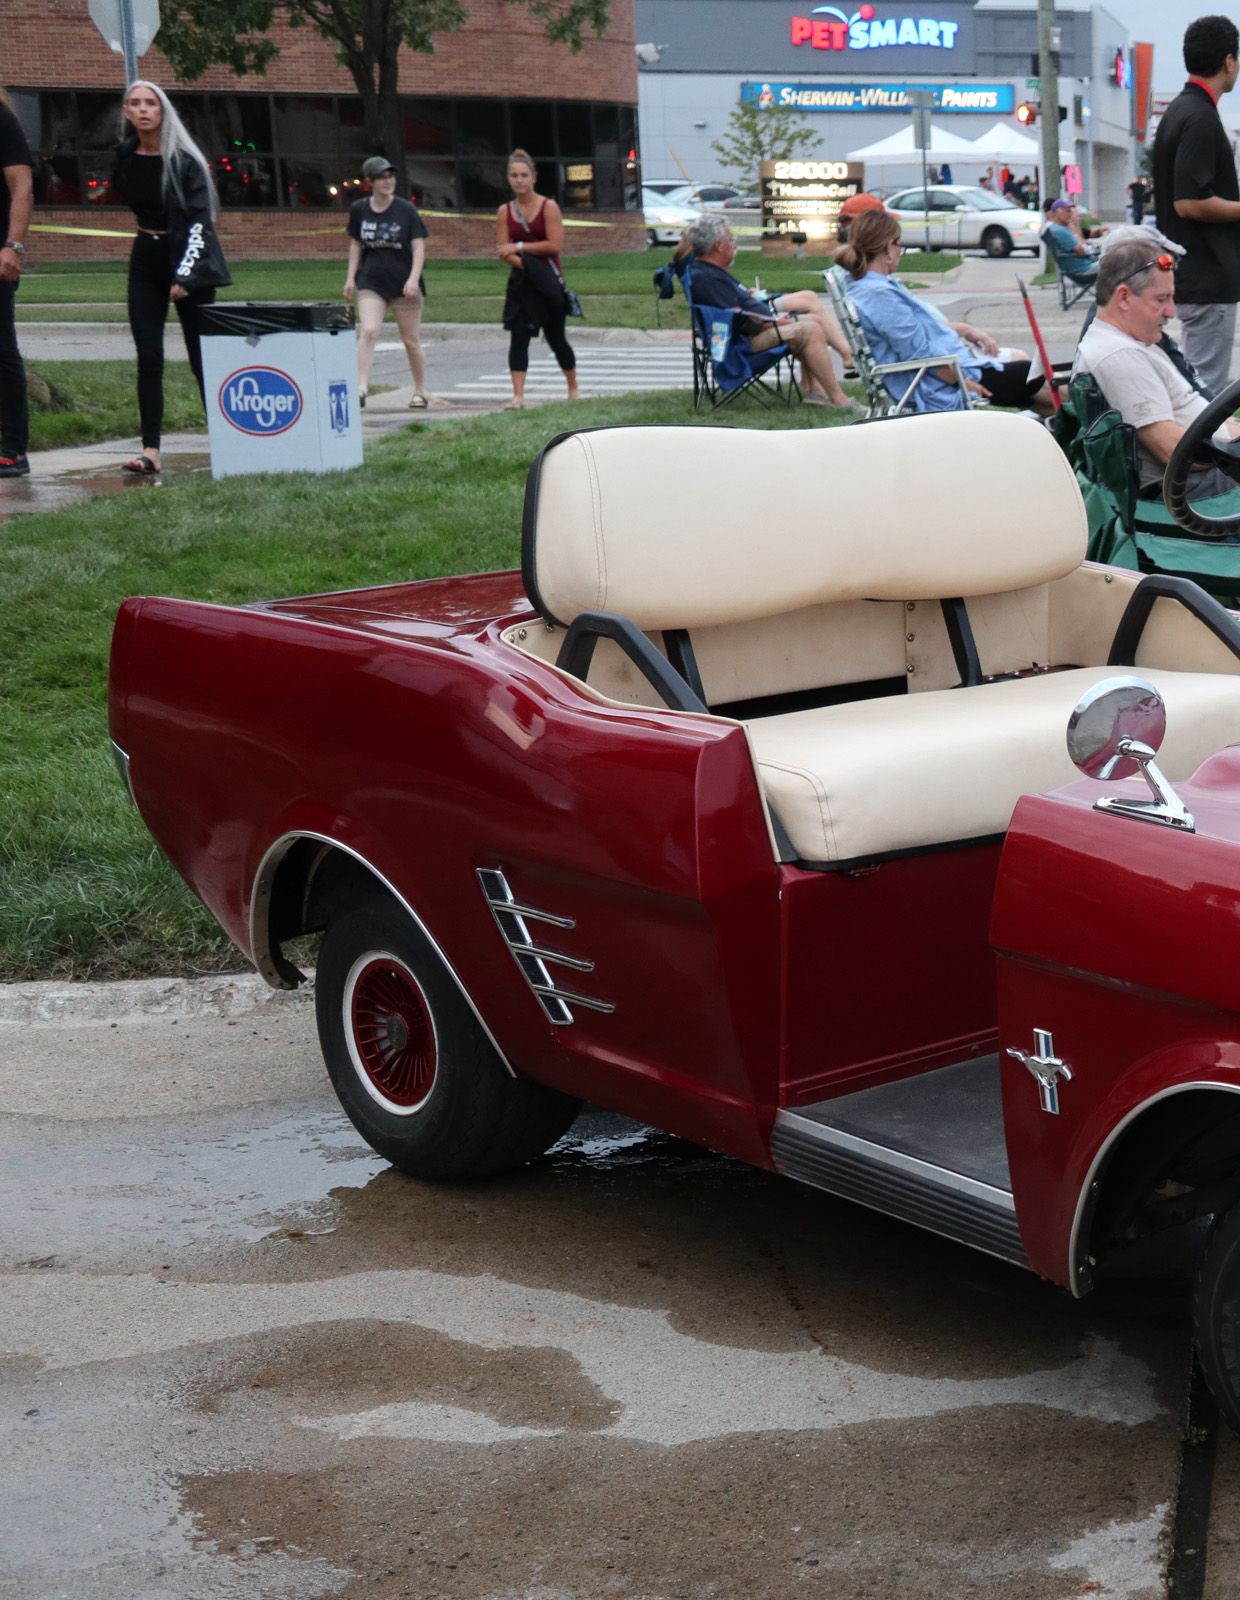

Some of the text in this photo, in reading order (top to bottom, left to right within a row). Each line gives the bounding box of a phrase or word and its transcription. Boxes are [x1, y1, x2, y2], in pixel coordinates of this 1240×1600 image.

[790, 15, 958, 50] PETSMART
[780, 87, 998, 107] SHERWIN-WILLI PAINTS
[774, 161, 848, 180] 28000
[177, 223, 205, 276] adidas
[229, 377, 295, 427] Kroger
